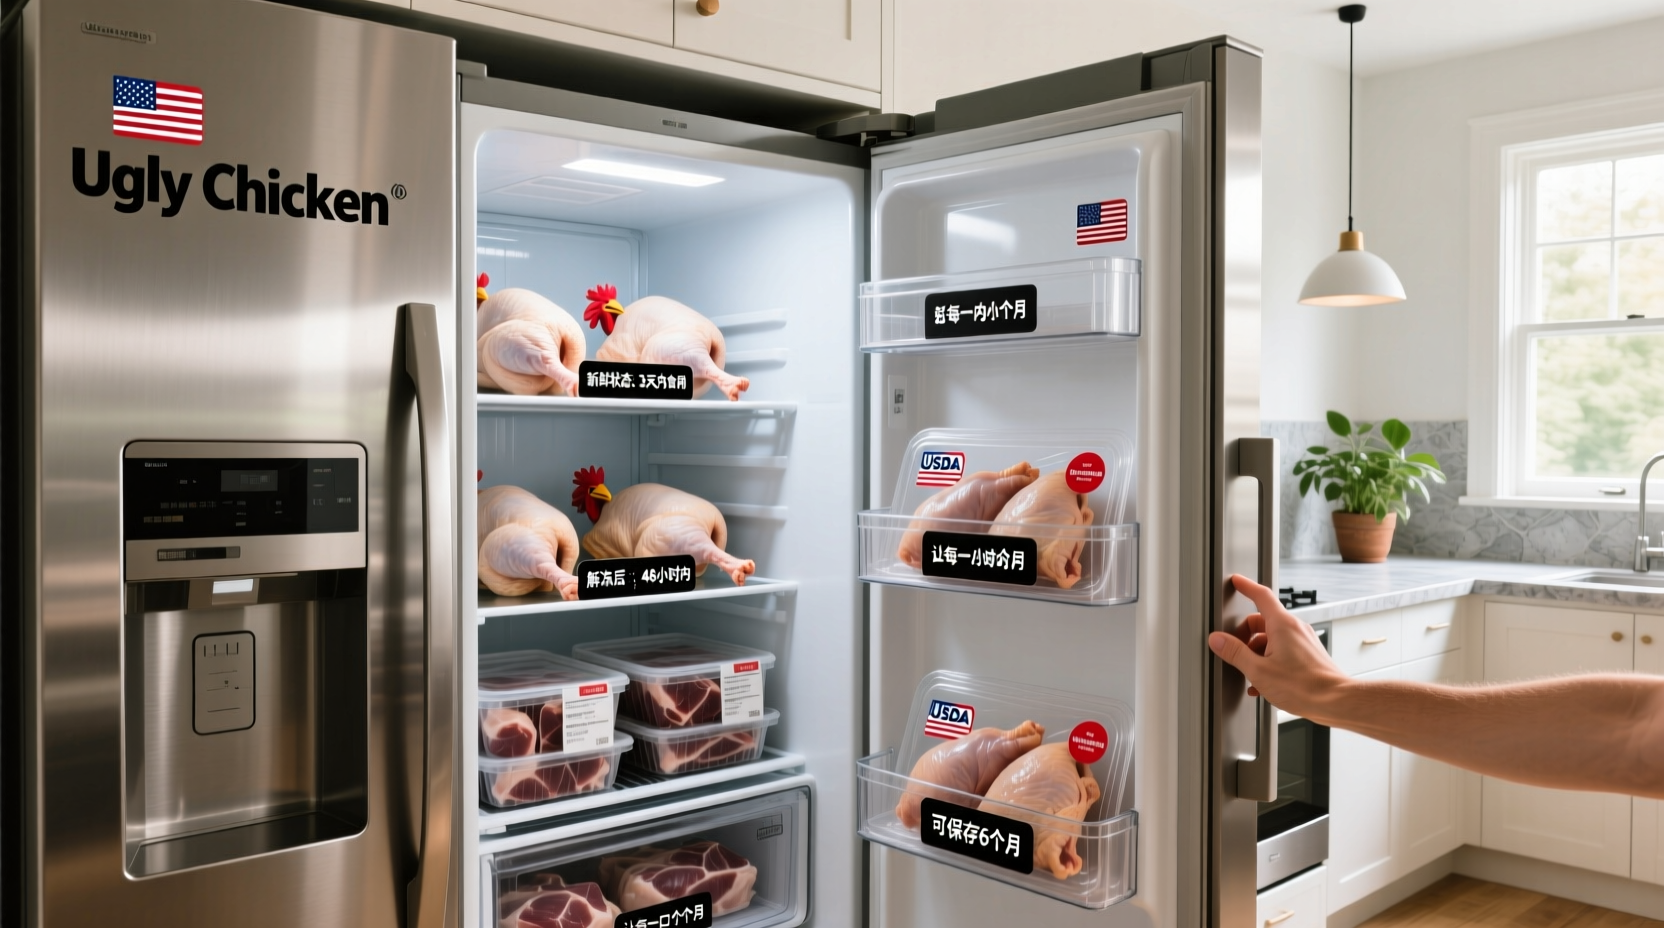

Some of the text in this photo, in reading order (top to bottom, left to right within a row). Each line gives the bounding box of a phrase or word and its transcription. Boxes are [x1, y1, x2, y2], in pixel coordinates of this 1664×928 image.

[72, 147, 193, 218] Ugly
[920, 453, 961, 471] USDA
[929, 702, 970, 726] USDA
[931, 813, 1020, 857] 可保存6个月
